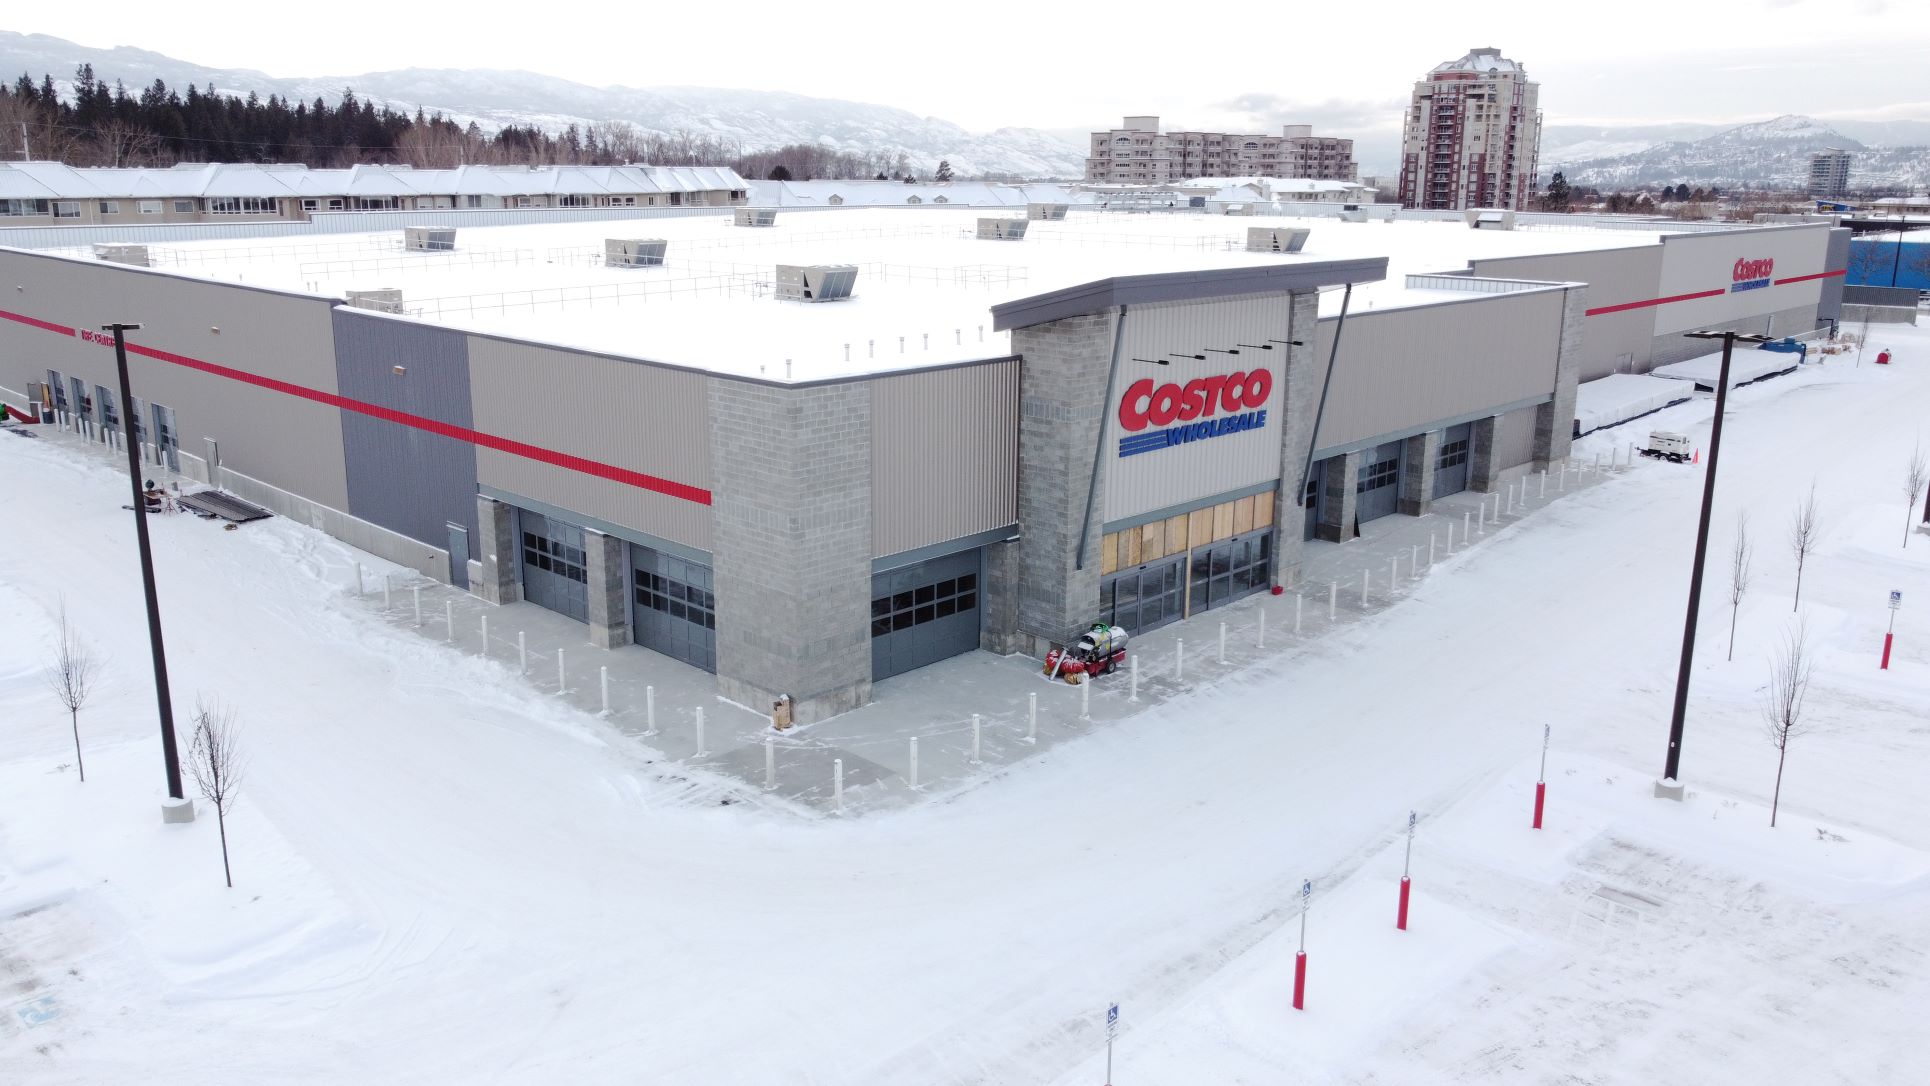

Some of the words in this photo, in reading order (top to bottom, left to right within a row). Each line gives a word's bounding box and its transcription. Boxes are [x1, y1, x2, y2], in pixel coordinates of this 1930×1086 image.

[1733, 257, 1773, 281] COSTCO
[1119, 368, 1273, 432] COSTCO
[1166, 410, 1267, 446] WHOLESALE
